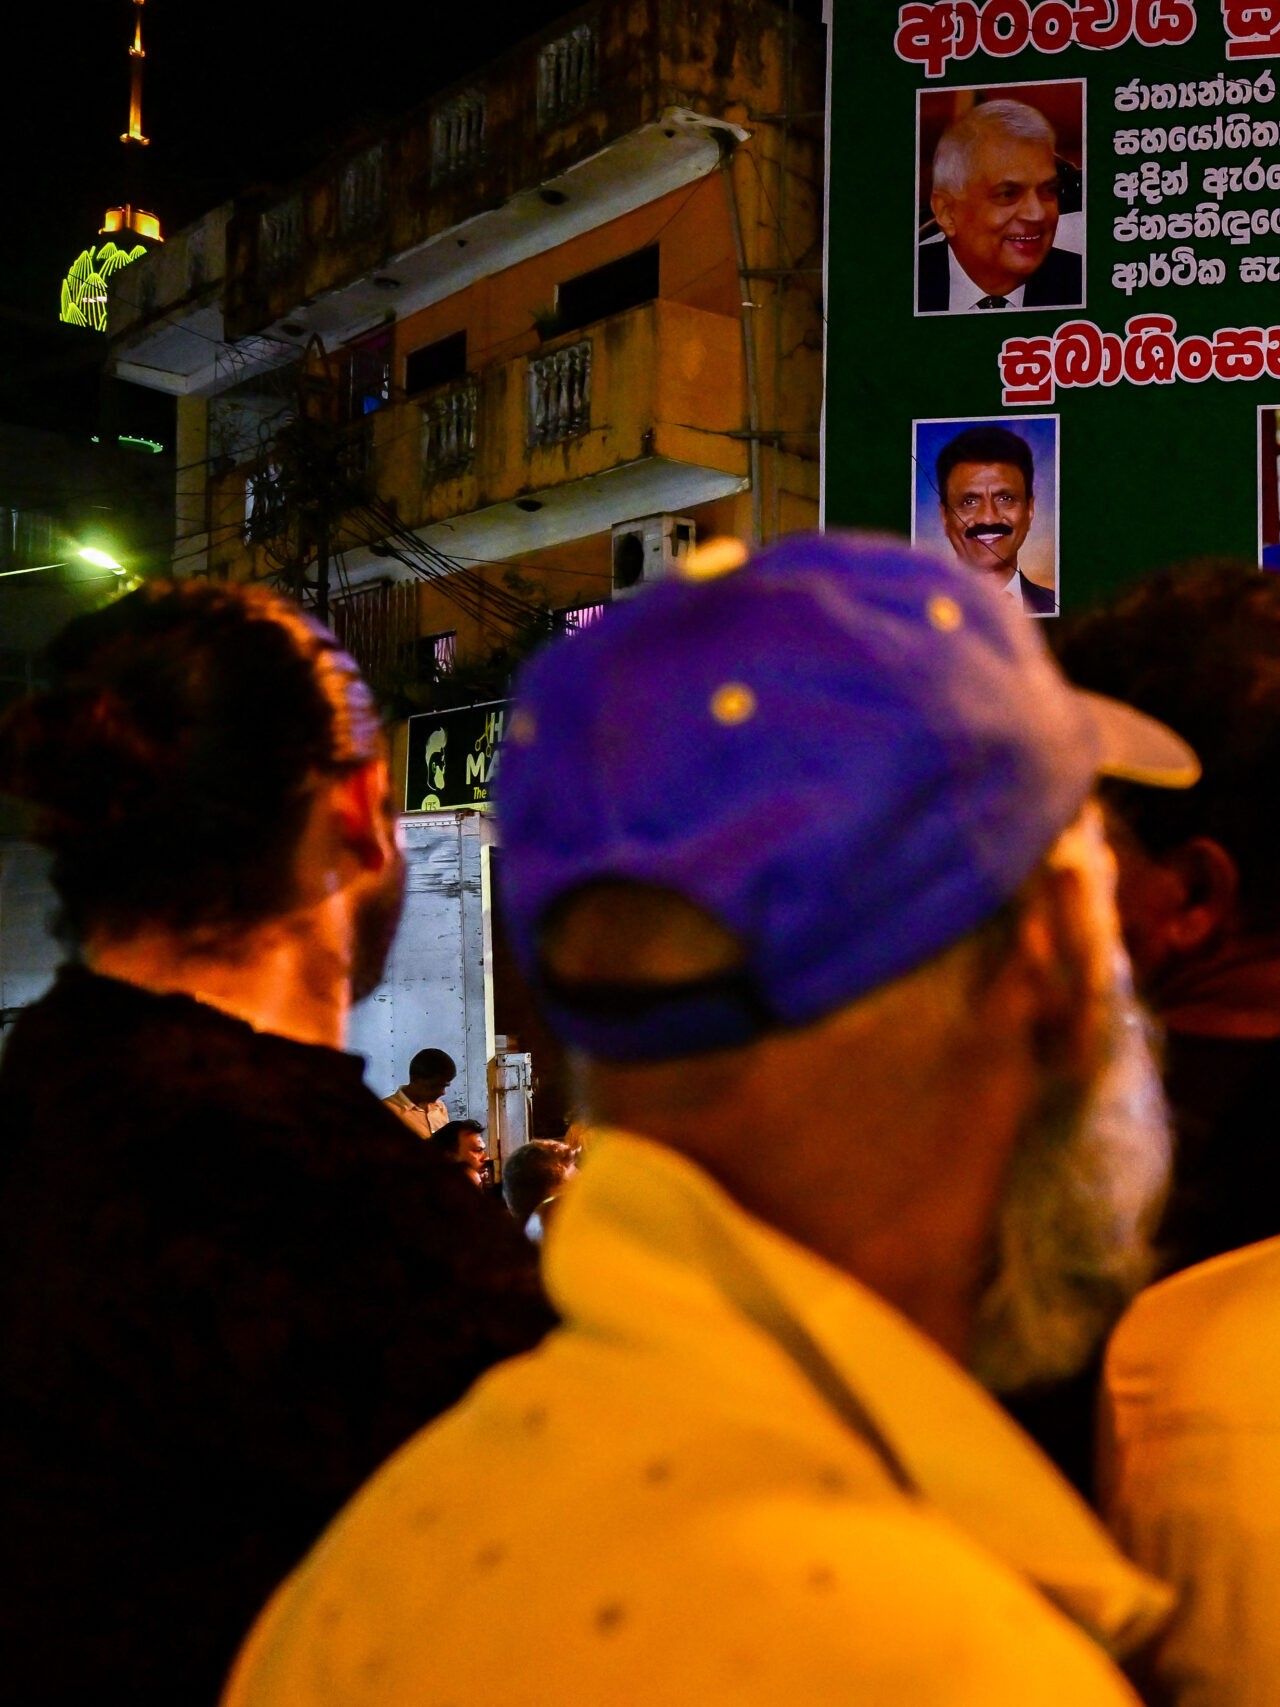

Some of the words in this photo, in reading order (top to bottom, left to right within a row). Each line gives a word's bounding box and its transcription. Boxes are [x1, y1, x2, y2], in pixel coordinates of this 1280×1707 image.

[894, 0, 1196, 78] ආරංචය
[1113, 161, 1189, 205] අදින්
[1111, 246, 1226, 295] ආර්ථික
[489, 710, 504, 743] H
[473, 786, 487, 800] The
